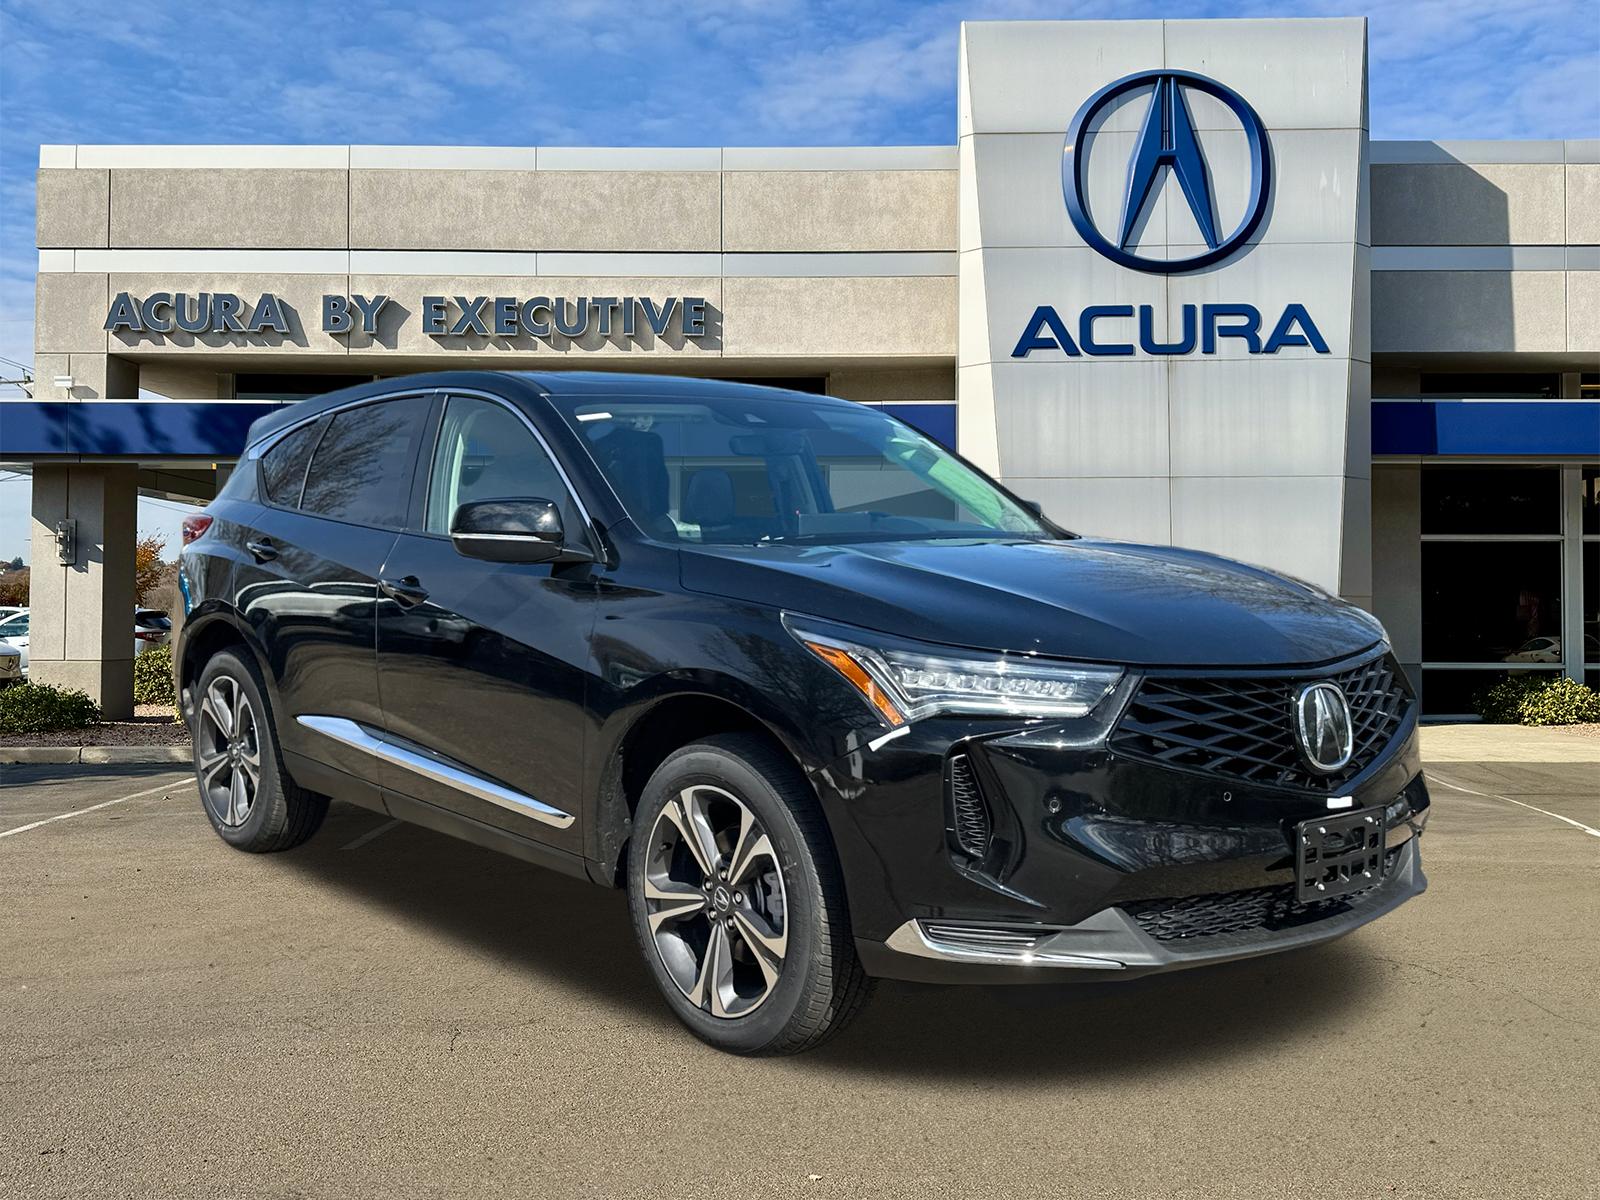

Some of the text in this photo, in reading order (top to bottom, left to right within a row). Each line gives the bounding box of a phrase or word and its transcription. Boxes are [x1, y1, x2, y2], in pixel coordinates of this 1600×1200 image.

[104, 292, 706, 337] ACURA BY EXECUTIVE
[1011, 303, 1331, 357] ACURA
